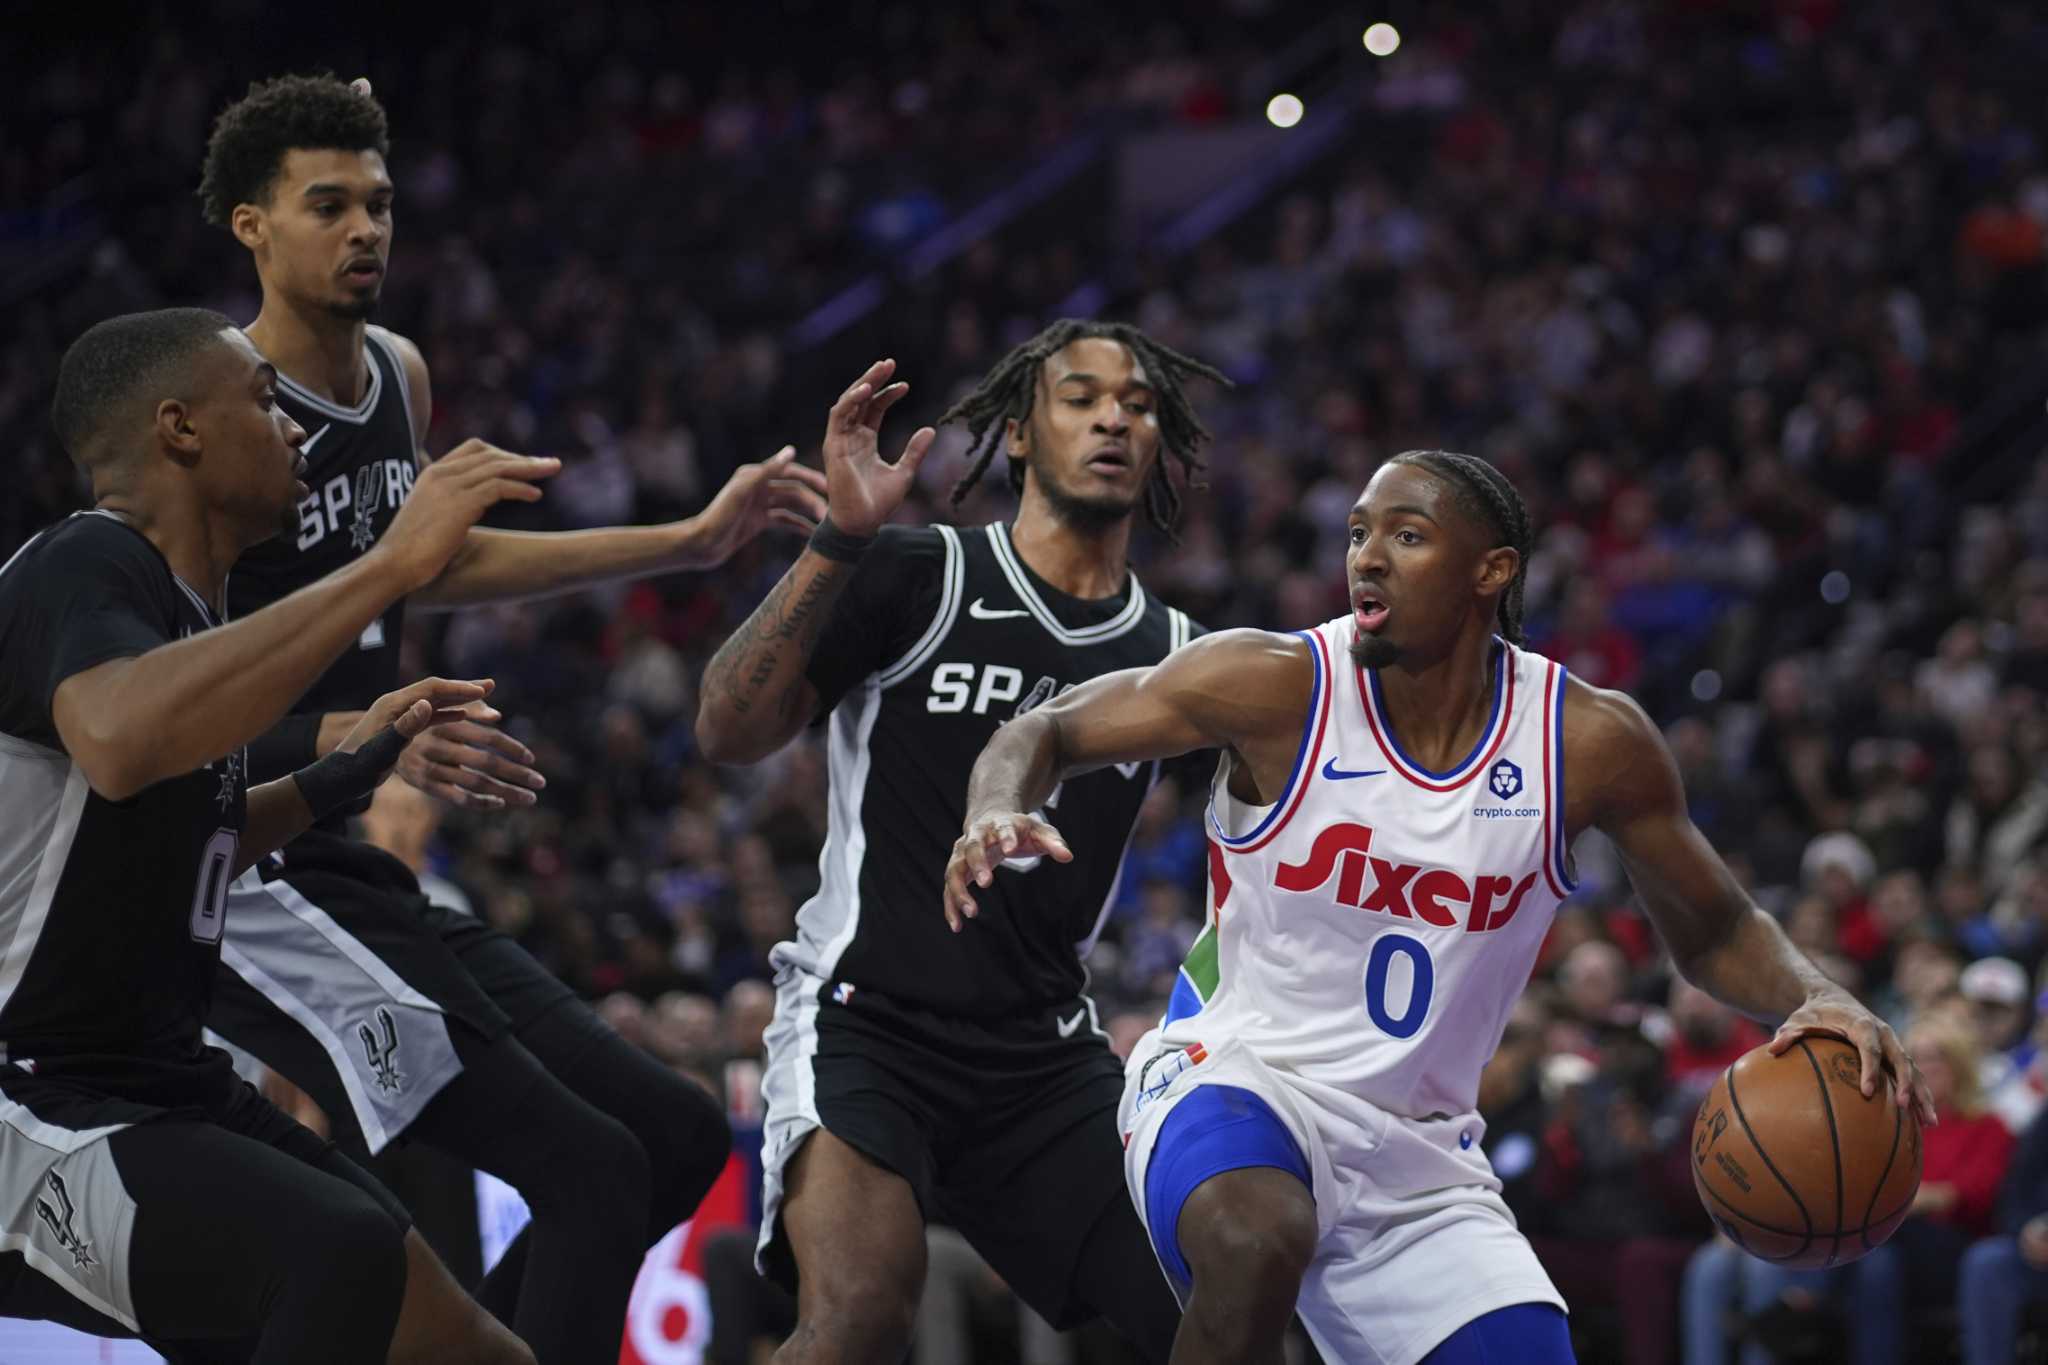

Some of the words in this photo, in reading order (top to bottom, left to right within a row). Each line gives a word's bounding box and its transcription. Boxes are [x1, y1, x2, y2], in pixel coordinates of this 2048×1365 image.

[1473, 807, 1541, 818] crypto.com
[189, 826, 240, 945] 0
[1273, 822, 1538, 933] Sixers
[1364, 933, 1435, 1040] 0
